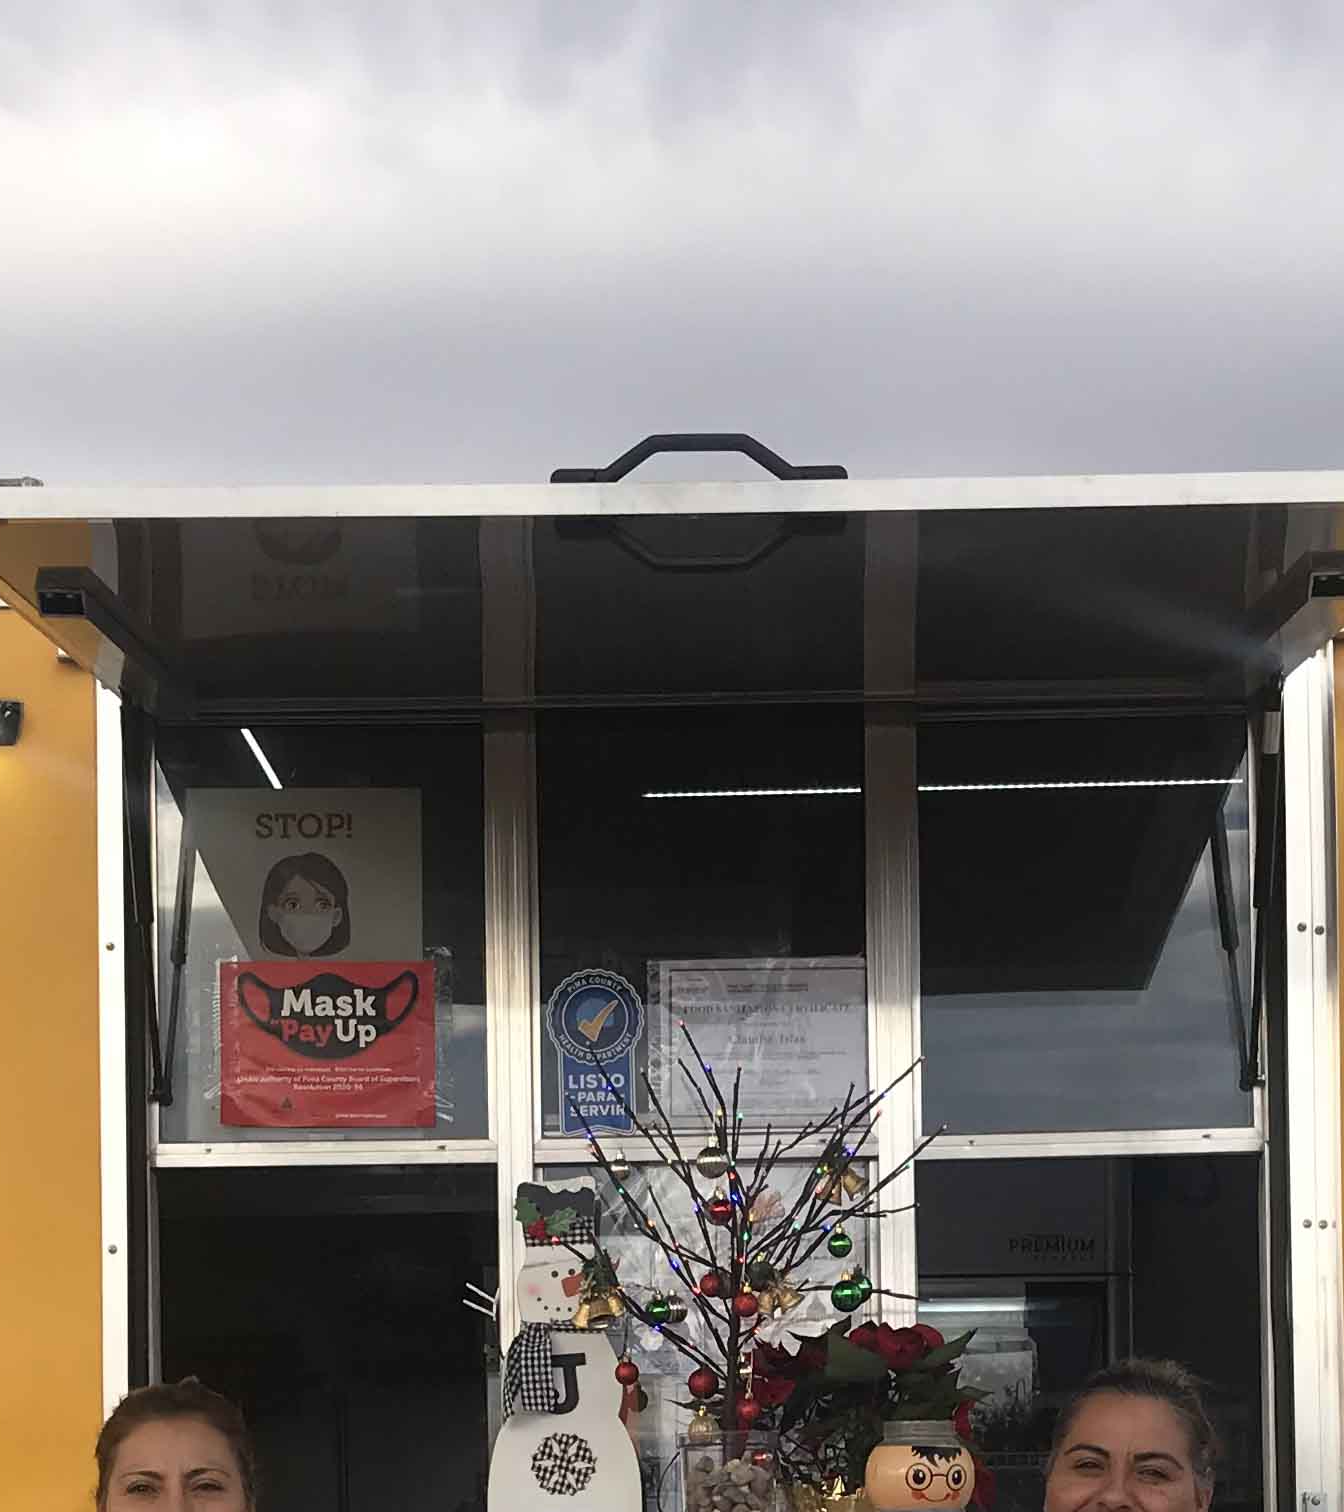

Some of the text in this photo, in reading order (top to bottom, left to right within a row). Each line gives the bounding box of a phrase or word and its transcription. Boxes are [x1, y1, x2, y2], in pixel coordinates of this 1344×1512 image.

[256, 813, 353, 840] STOP!
[567, 975, 624, 993] PIMA COUNTY
[281, 988, 376, 1017] Mask
[282, 1019, 376, 1047] Pay Up
[558, 1033, 583, 1060] HEALTH
[568, 1073, 624, 1088] LISTO
